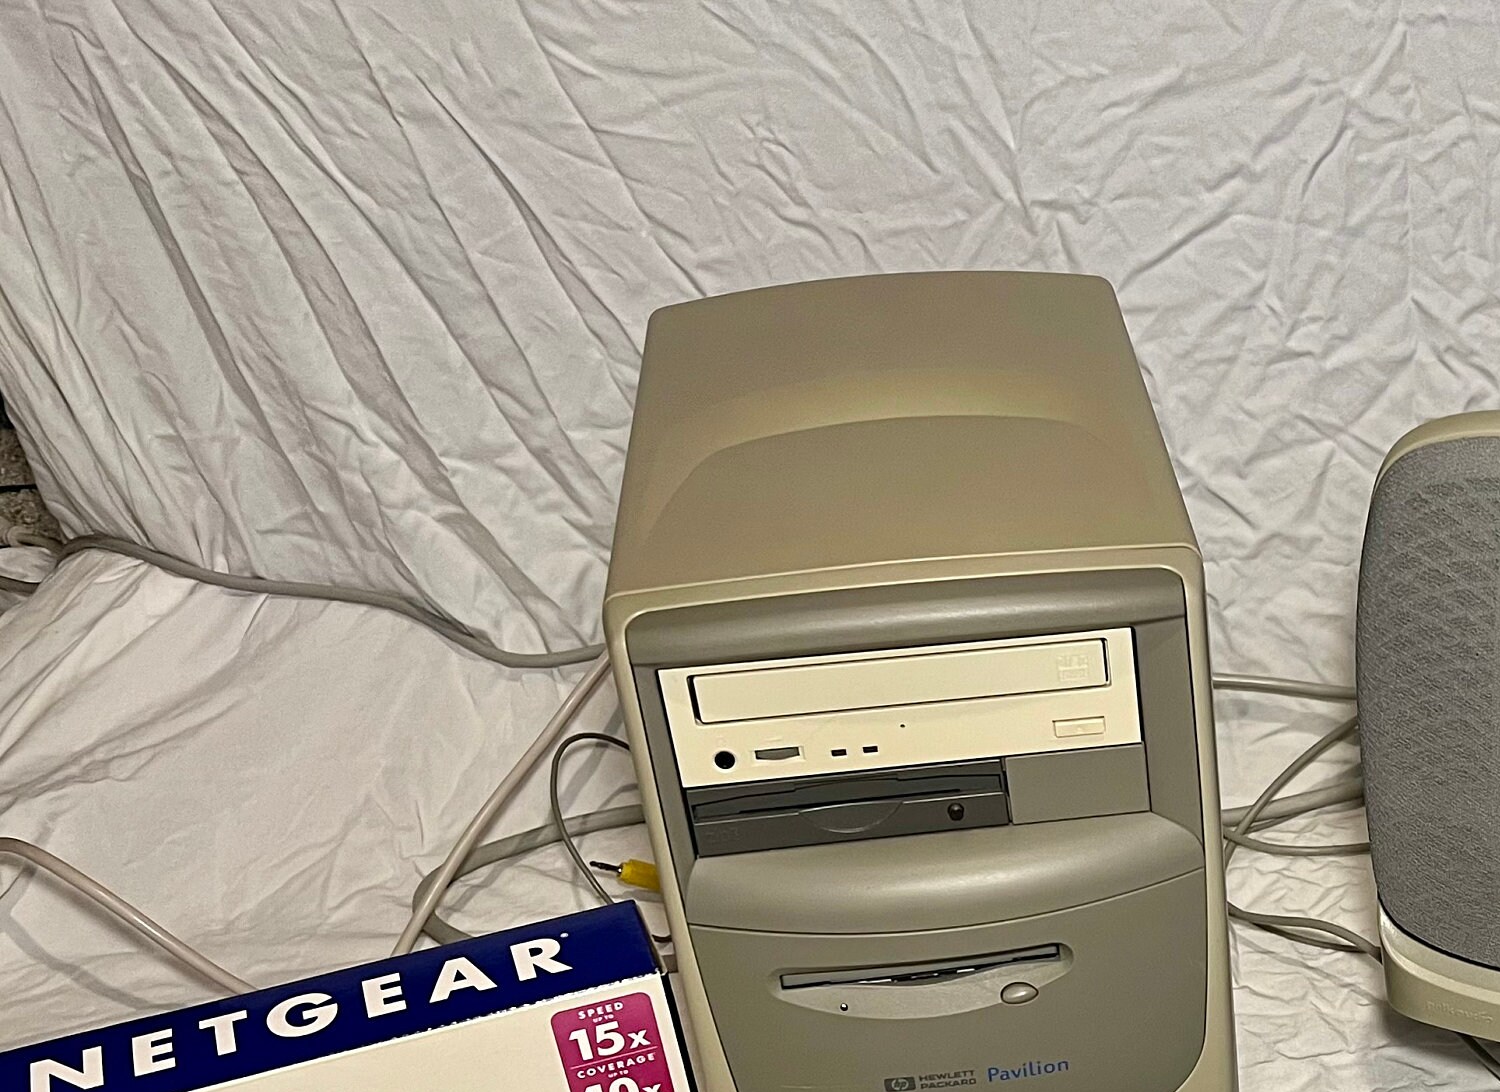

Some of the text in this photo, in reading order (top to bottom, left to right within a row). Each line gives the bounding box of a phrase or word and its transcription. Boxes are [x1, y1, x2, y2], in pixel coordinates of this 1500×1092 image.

[578, 1001, 624, 1020] SPEED
[569, 1020, 651, 1062] 15x
[577, 1053, 656, 1079] COVERAGE
[919, 1070, 976, 1082] HEWLETT
[987, 1060, 1070, 1083] Pavilion
[920, 1078, 977, 1090] PACKARD
